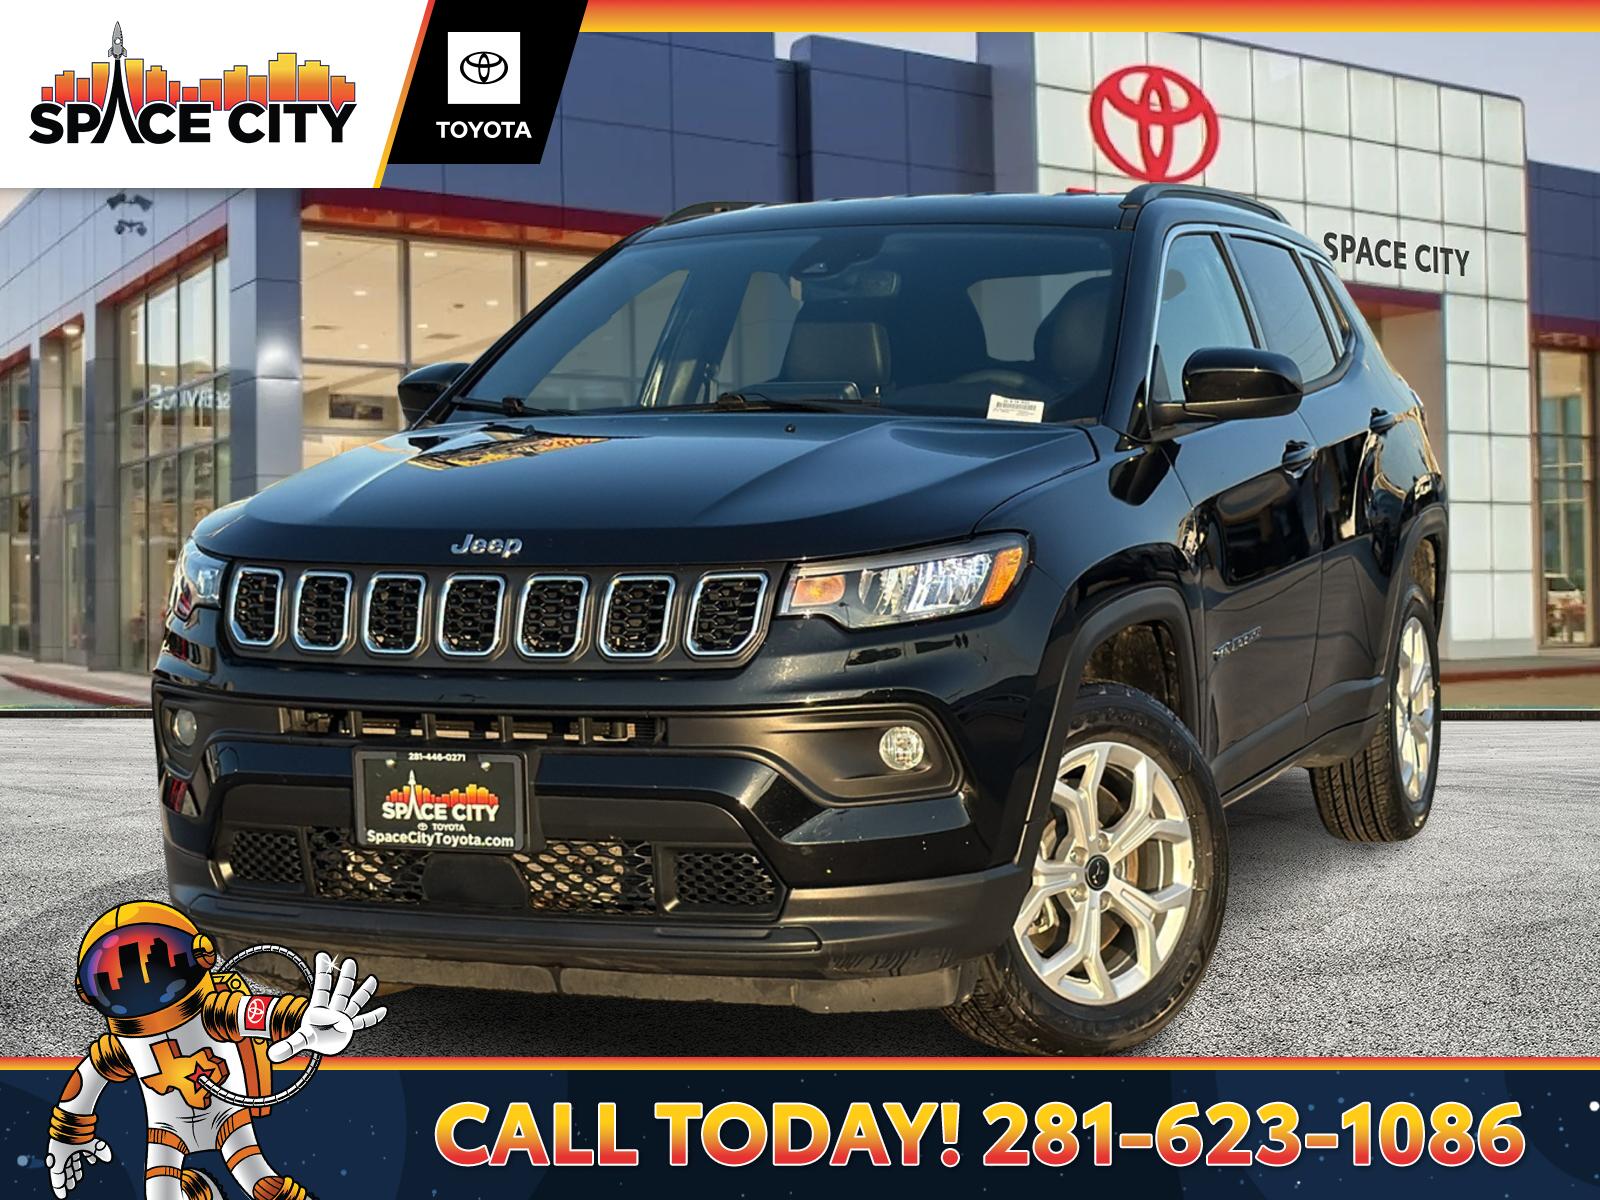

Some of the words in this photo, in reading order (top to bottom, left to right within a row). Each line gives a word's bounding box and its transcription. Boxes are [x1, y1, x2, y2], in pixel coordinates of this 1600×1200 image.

[1323, 232, 1407, 270] SPACE
[1415, 244, 1470, 277] CITY
[450, 533, 523, 558] Jeep
[452, 803, 499, 822] CITY
[432, 823, 466, 832] TOYOTA
[367, 829, 514, 848] SpaceCityToyota.com
